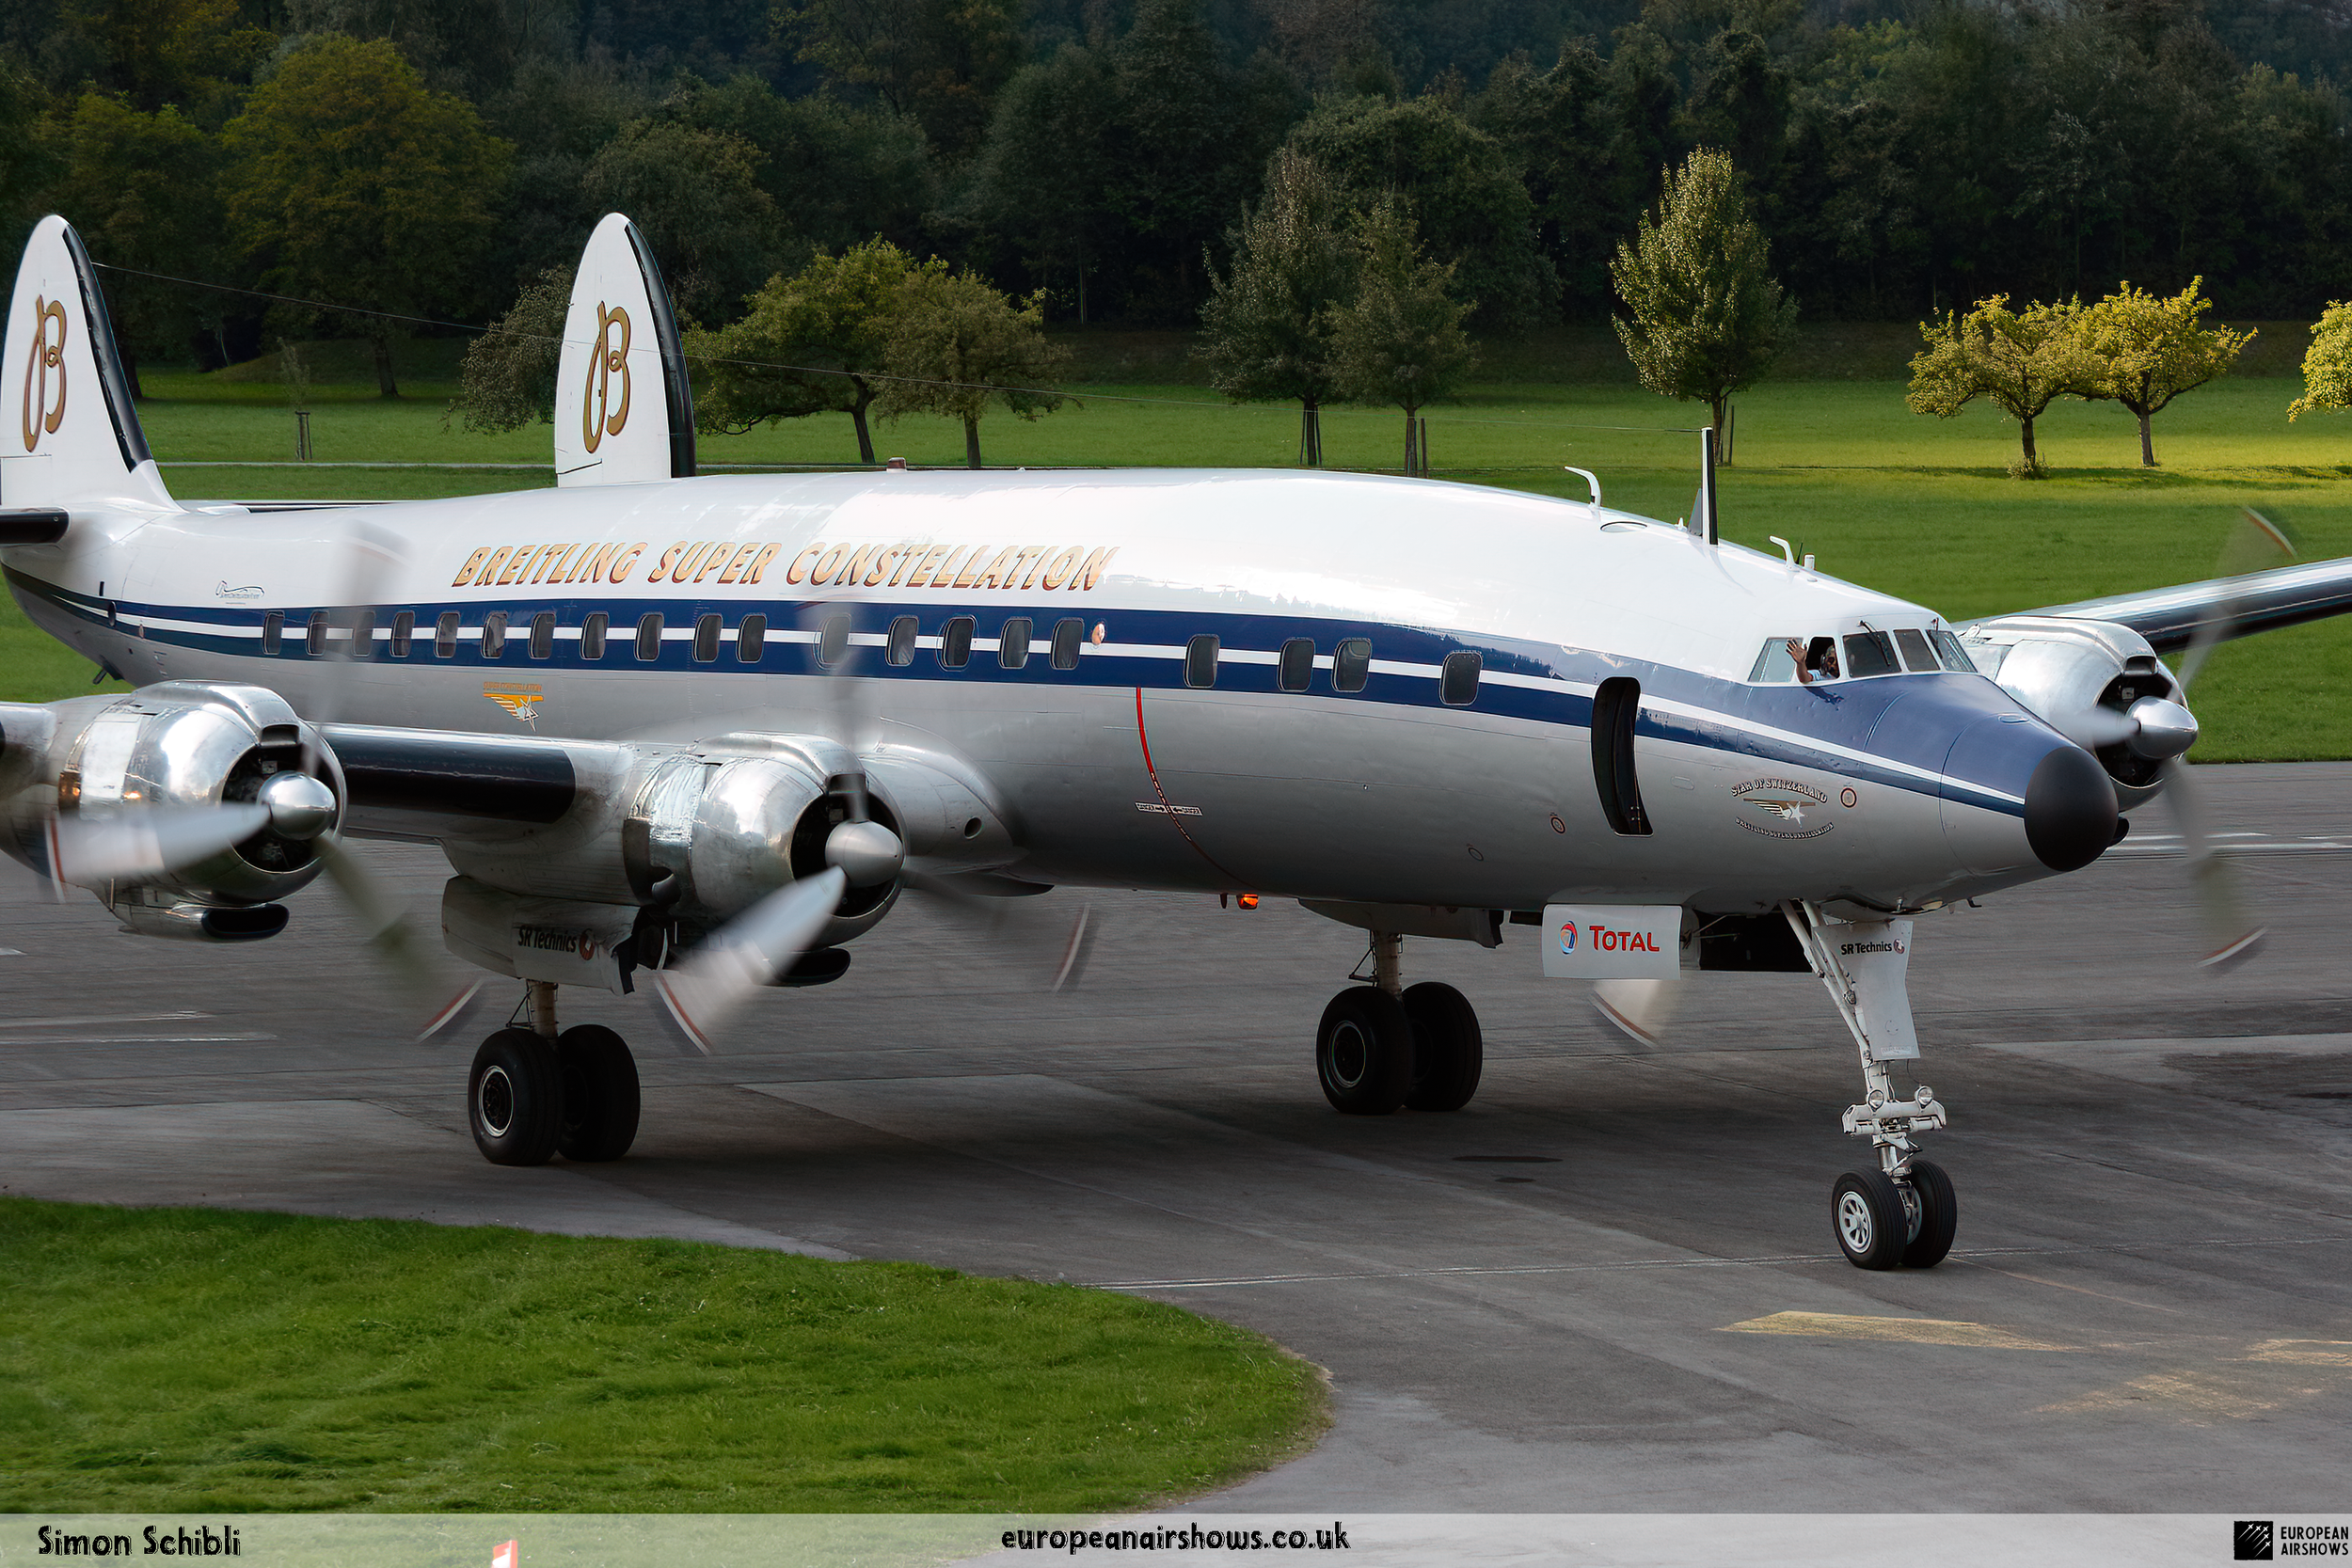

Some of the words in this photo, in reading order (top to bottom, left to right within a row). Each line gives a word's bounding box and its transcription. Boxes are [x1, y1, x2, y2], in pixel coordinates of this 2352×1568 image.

[452, 543, 648, 588] BREITLING
[647, 540, 782, 586] SUPER
[786, 542, 1120, 592] CONSTELLATION
[1731, 781, 1753, 797] STAR
[1754, 778, 1765, 790] OF
[1766, 778, 1827, 803] SWITZERLAND
[517, 925, 532, 948] SR
[533, 927, 578, 954] Technics
[1589, 925, 1661, 952] TOTAL
[1840, 943, 1854, 956] SR
[1854, 941, 1893, 954] Technics
